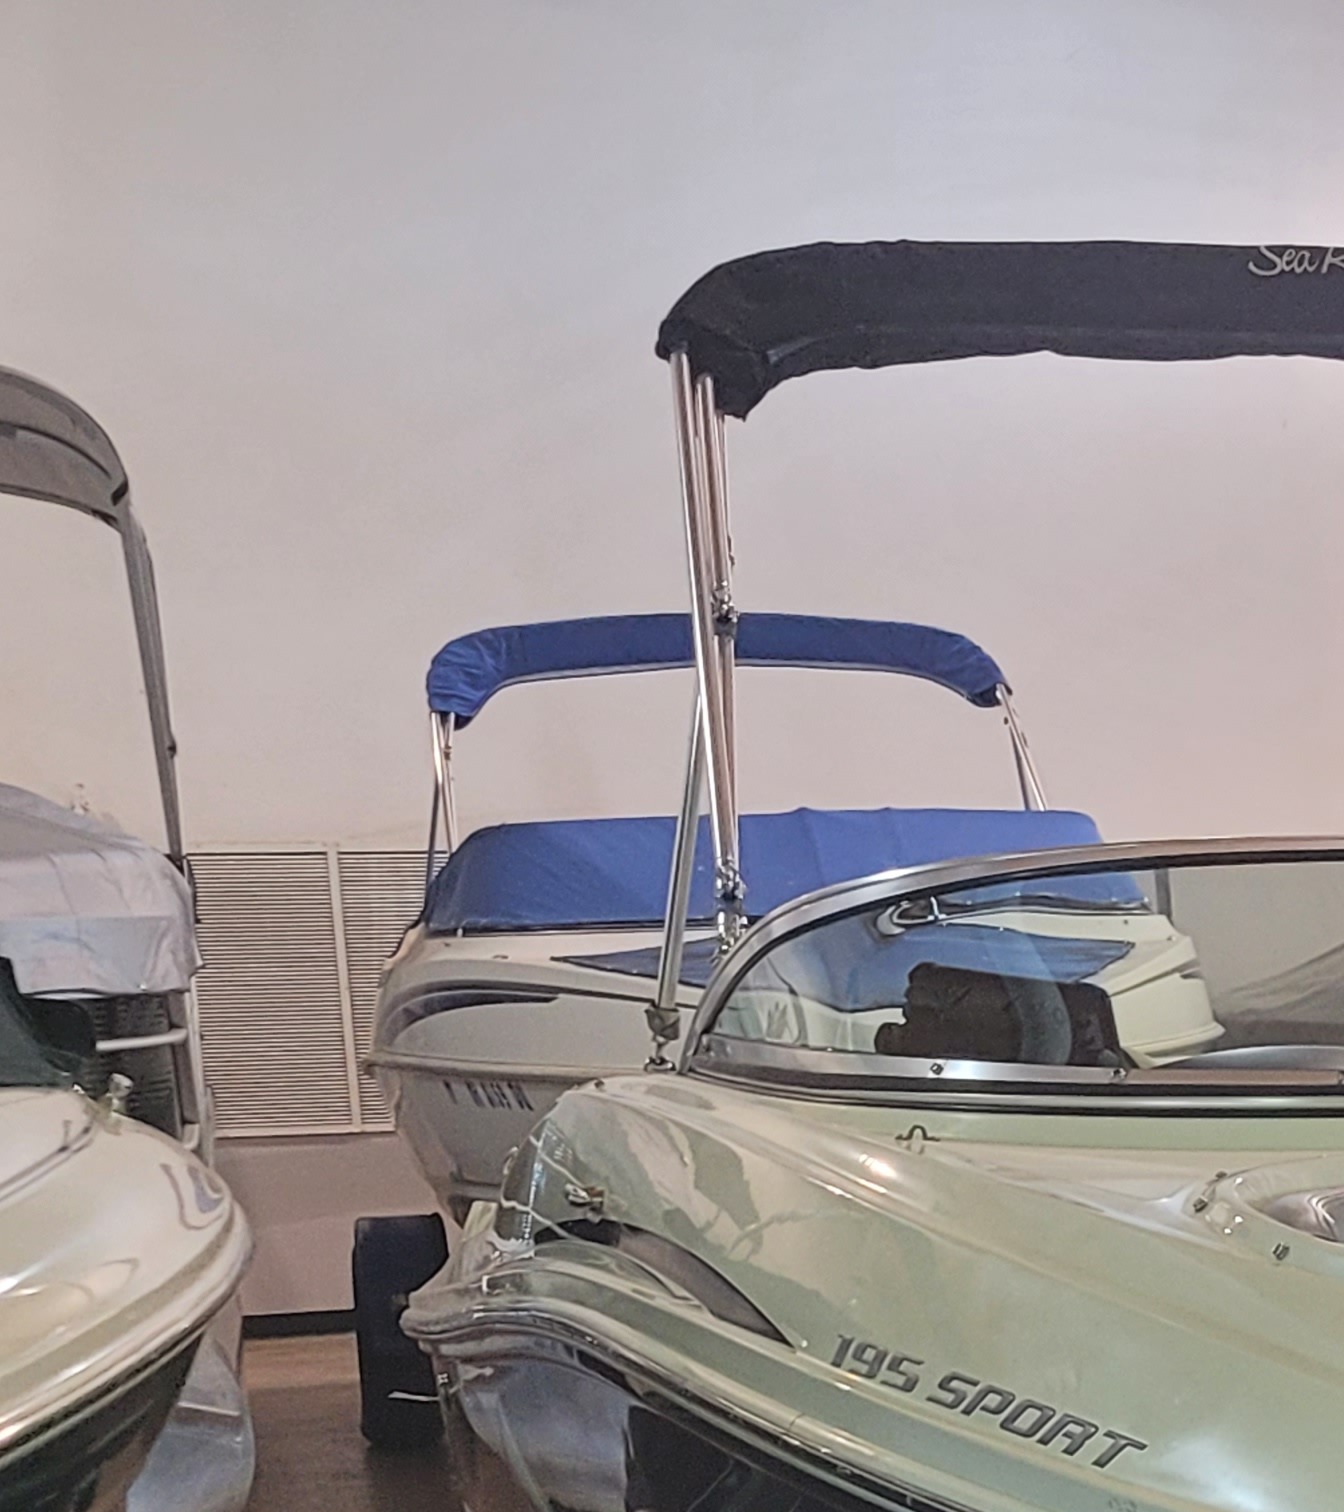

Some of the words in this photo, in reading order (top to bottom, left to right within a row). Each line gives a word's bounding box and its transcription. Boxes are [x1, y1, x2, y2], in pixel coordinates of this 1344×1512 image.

[1248, 245, 1319, 277] Sea
[830, 1334, 924, 1393] 195
[925, 1370, 1149, 1469] SPORT
